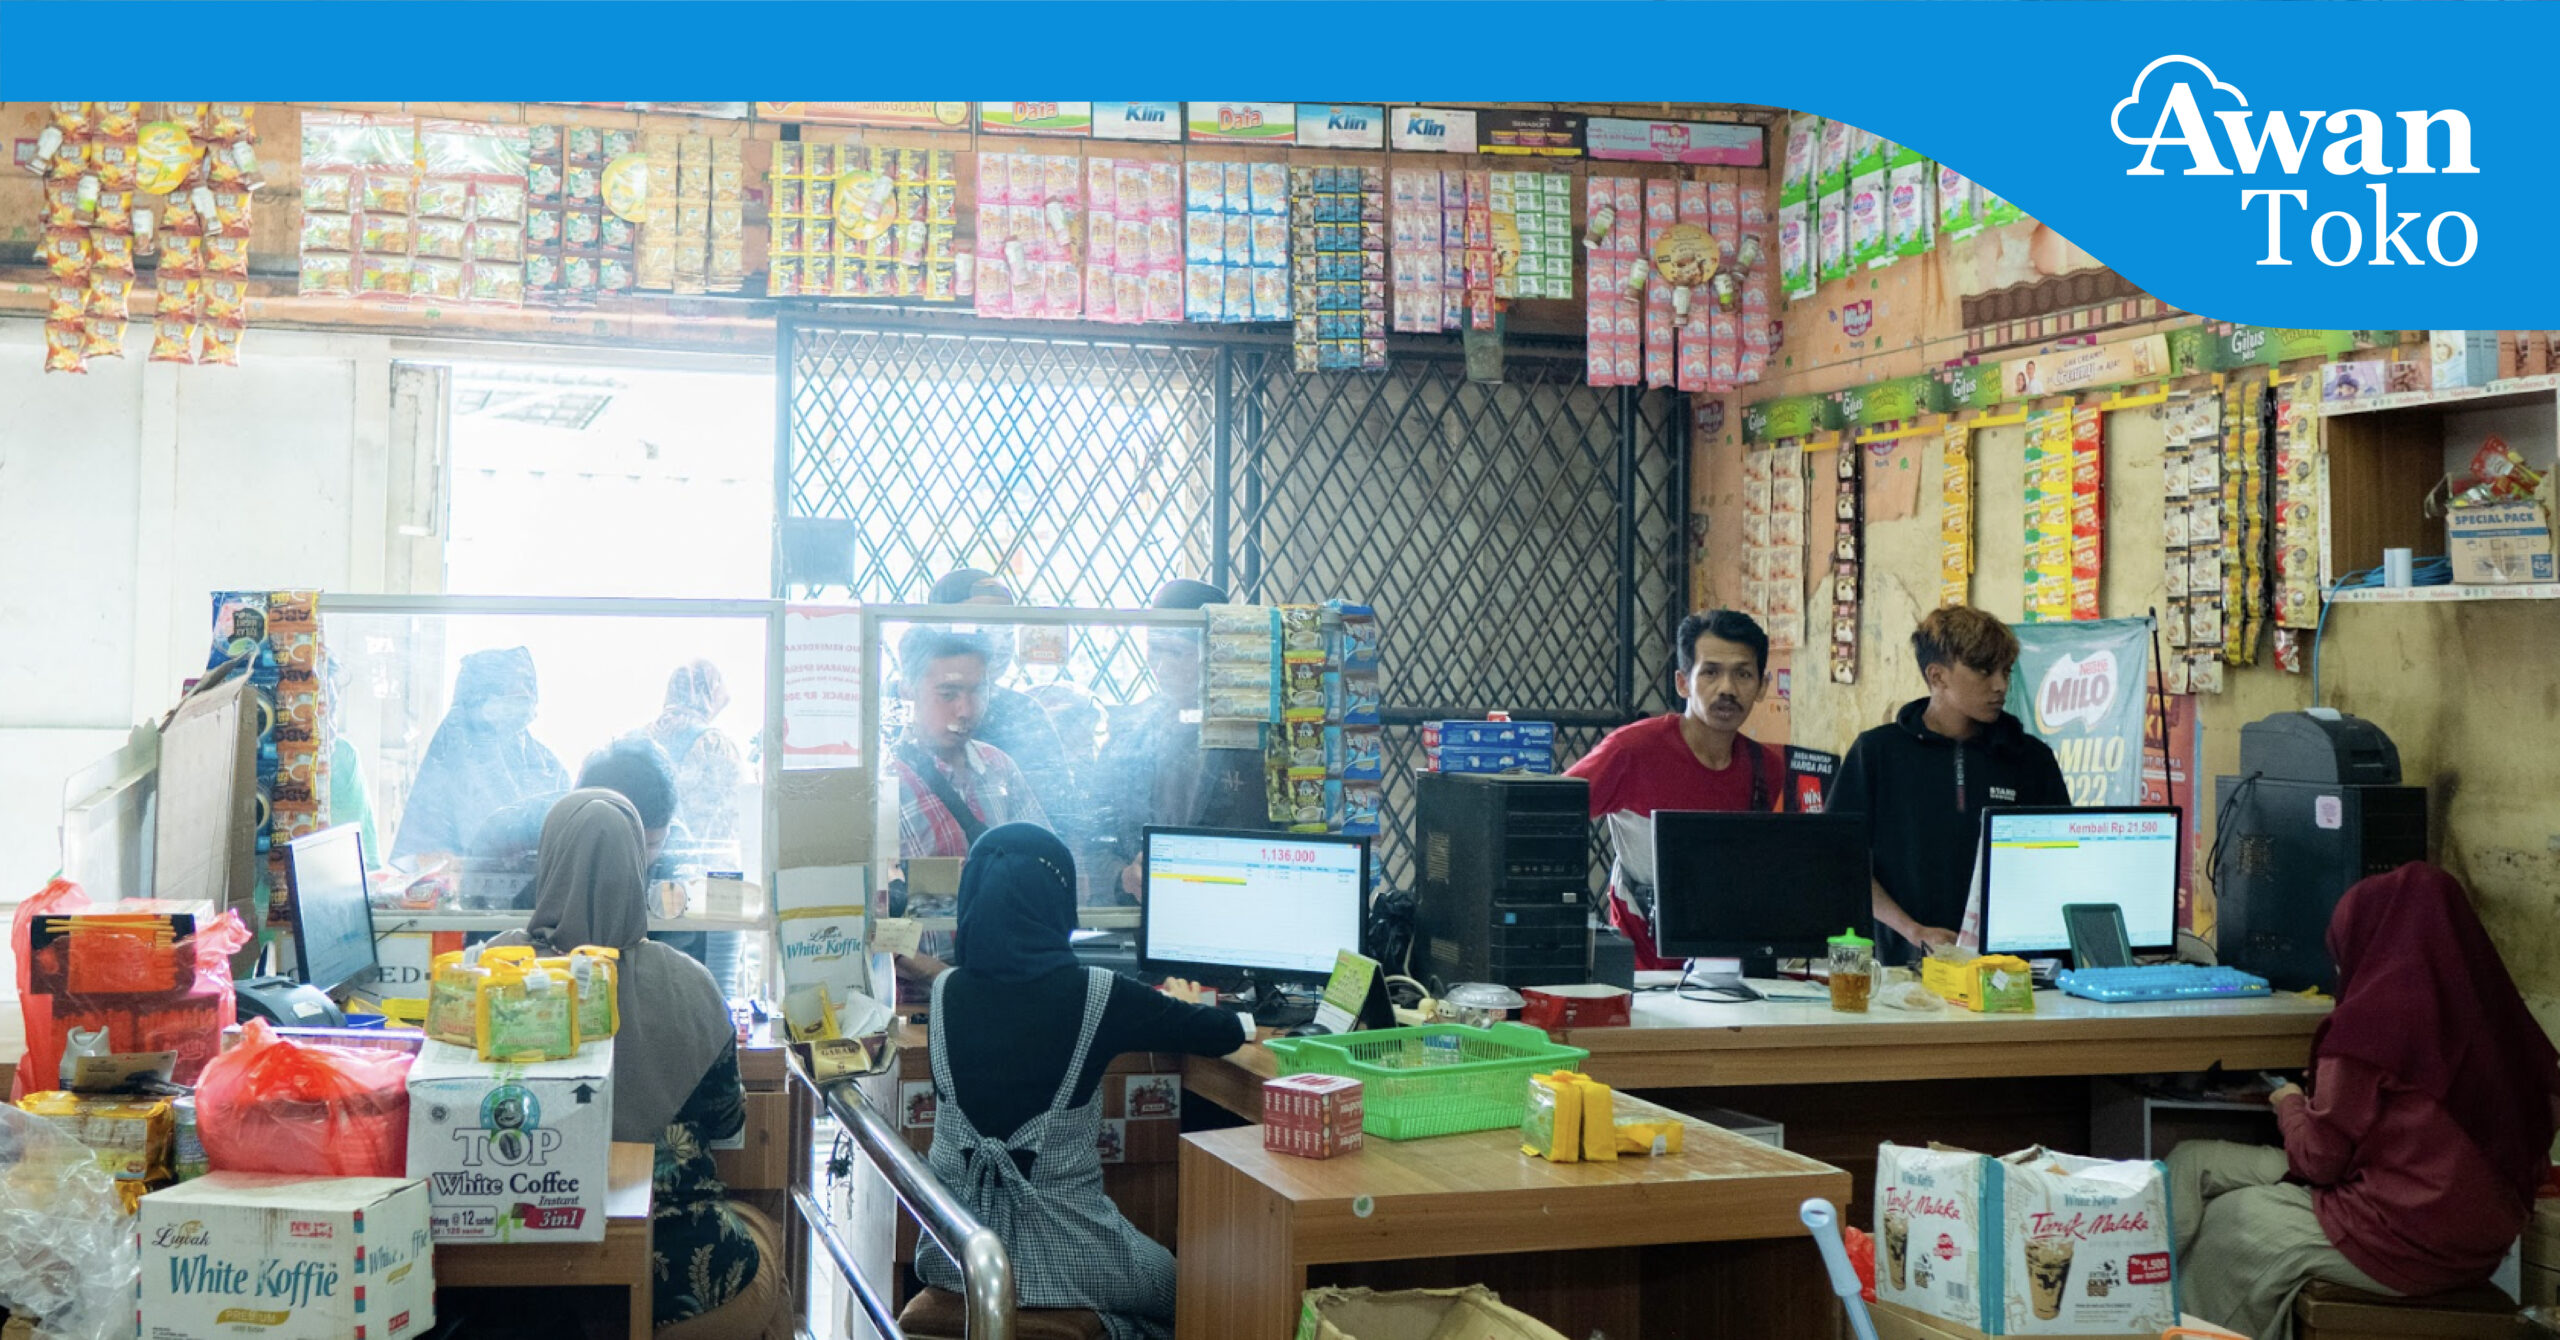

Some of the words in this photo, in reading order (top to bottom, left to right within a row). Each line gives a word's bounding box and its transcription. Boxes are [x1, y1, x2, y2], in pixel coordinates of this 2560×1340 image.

[1124, 106, 1165, 122] Klin
[1217, 107, 1263, 133] Daia
[1327, 114, 1367, 131] Klin
[1407, 119, 1445, 137] Klin
[2455, 513, 2503, 525] SPECIAL
[2504, 512, 2535, 523] PACK
[2046, 674, 2110, 714] MILO
[2059, 735, 2125, 773] MILO
[1791, 760, 1815, 771] HARGA
[2069, 823, 2109, 833] Kembali
[2111, 822, 2124, 835] Rp
[1261, 848, 1315, 864] 1,136,000
[786, 940, 823, 960] White
[453, 1127, 562, 1166] TOP
[432, 1170, 503, 1196] White
[509, 1170, 580, 1195] Coffee
[538, 1195, 580, 1206] Instant
[461, 1211, 475, 1226] 12
[539, 1208, 578, 1227] 3in1
[170, 1254, 249, 1295] White
